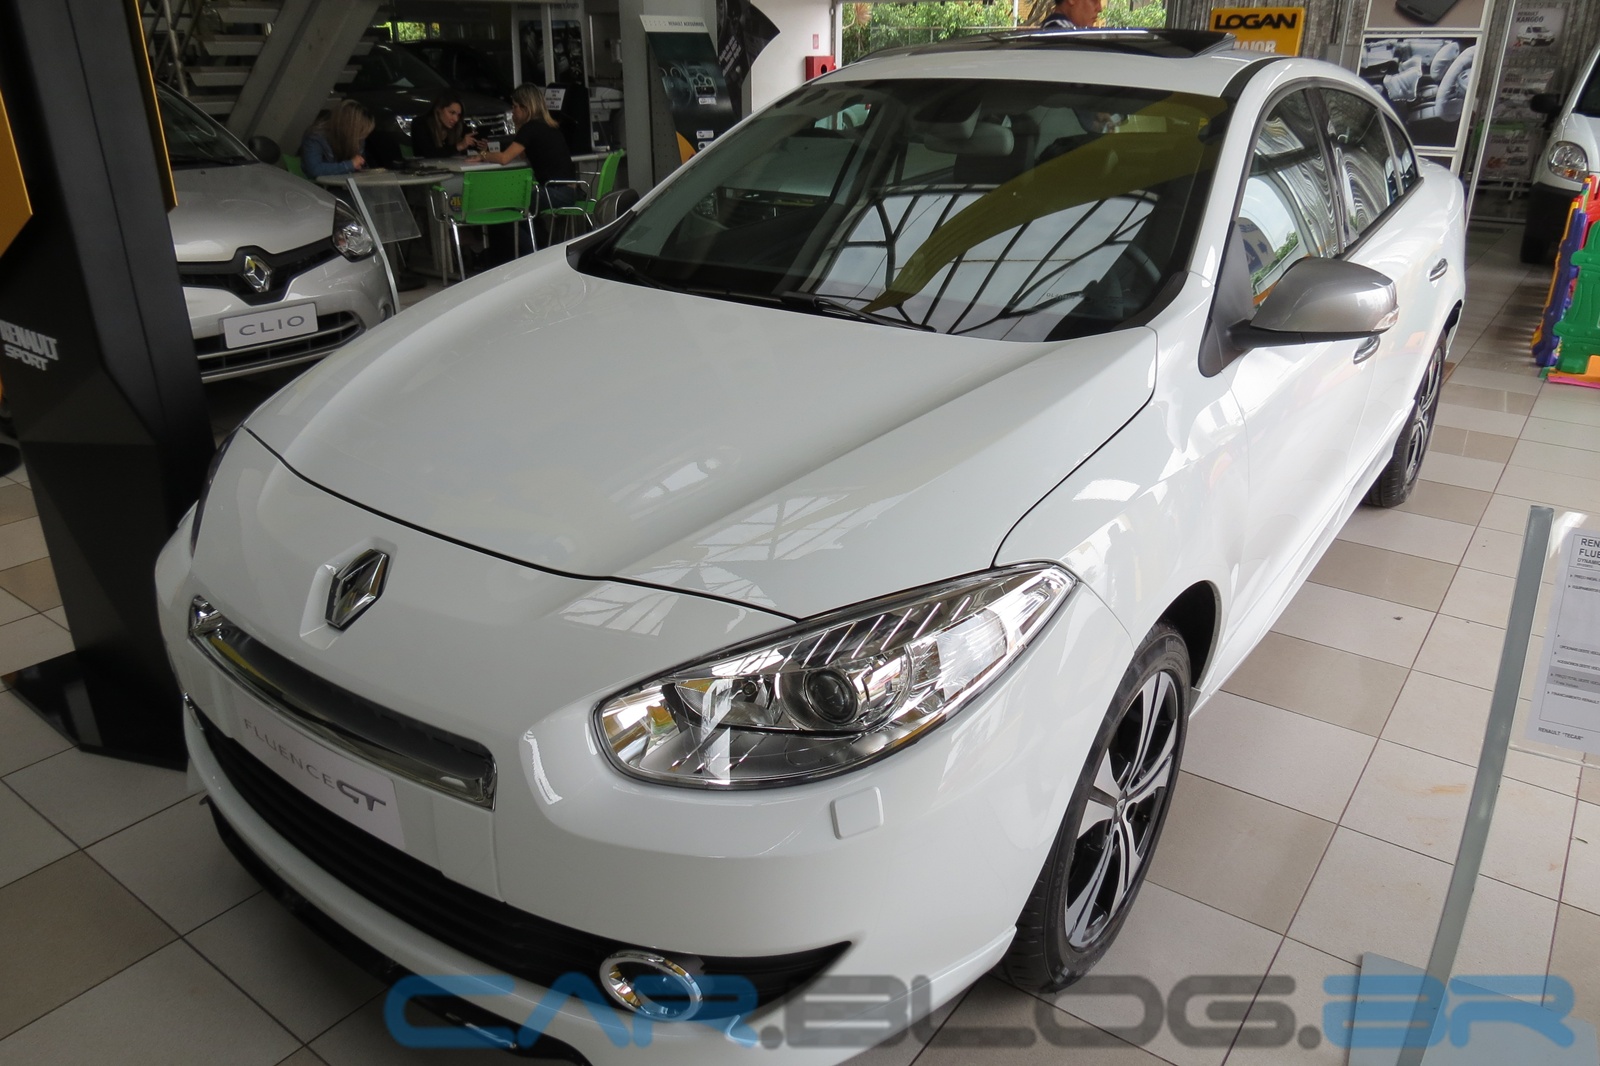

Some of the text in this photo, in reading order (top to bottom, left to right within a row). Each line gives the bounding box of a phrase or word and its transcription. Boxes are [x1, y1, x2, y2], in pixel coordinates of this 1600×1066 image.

[1214, 13, 1297, 29] LOGAN
[239, 315, 305, 336] CLIO
[4, 343, 48, 371] SPORT
[1538, 727, 1561, 736] RENAULT
[243, 718, 387, 812] FLUENCE GT
